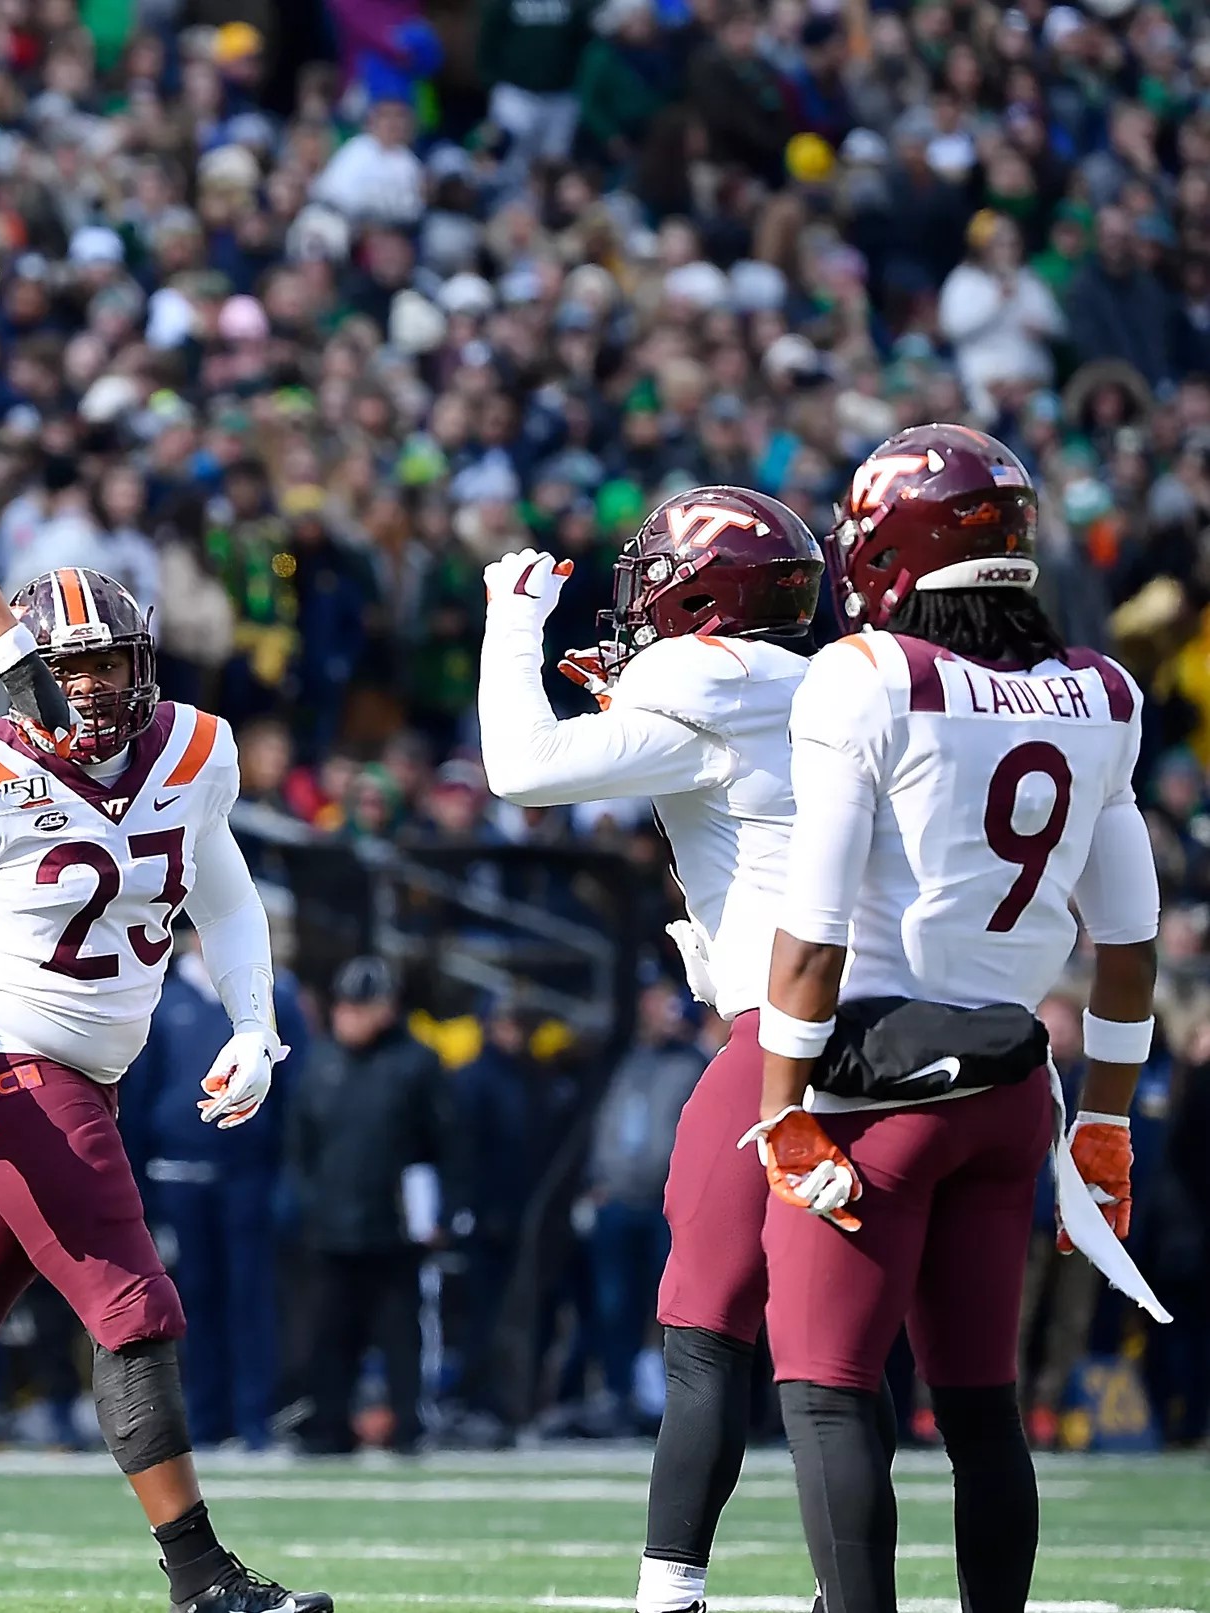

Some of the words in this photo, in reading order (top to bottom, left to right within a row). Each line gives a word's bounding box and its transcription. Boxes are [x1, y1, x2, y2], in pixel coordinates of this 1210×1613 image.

[851, 454, 928, 513] VT
[666, 504, 760, 548] VT
[975, 567, 1032, 582] HOKIES
[964, 669, 1090, 718] LADLER
[101, 797, 128, 815] VT
[984, 741, 1072, 933] 9
[35, 826, 188, 981] 23
